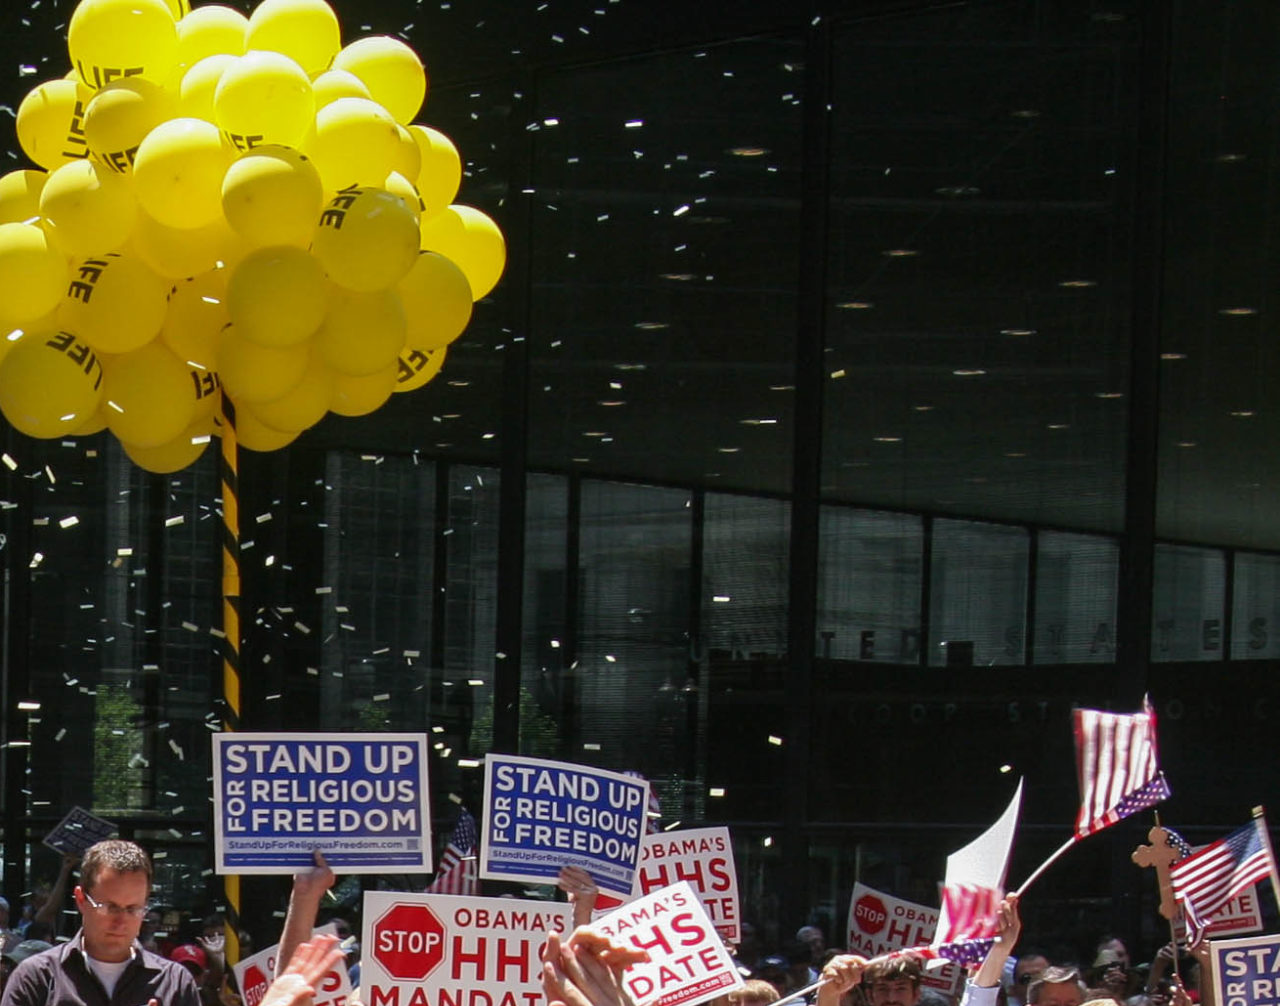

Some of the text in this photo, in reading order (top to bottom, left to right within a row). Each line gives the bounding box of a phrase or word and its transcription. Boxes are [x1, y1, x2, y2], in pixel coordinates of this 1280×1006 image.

[46, 330, 103, 392] LIFE
[226, 745, 414, 773] STAND UP
[251, 779, 415, 803] RELIGIOUS
[496, 766, 640, 811] STAND UP
[227, 780, 246, 832] FOR
[252, 809, 417, 832] FREEDOM
[493, 796, 511, 843] FOR
[517, 797, 638, 839] RELIGIOUS
[228, 840, 403, 851] StandUpForReligiousFreedom.com
[515, 823, 636, 865] FREEDOM
[639, 858, 731, 896] HHS
[454, 908, 565, 934] OBAMA'S
[601, 892, 687, 937] BAMA'S
[855, 904, 885, 924] STOP
[894, 906, 939, 926] OBAM
[379, 929, 440, 954] STOP
[628, 913, 706, 960] HS
[886, 918, 936, 947] HH
[628, 947, 724, 999] DATE
[245, 982, 268, 1006] STOP
